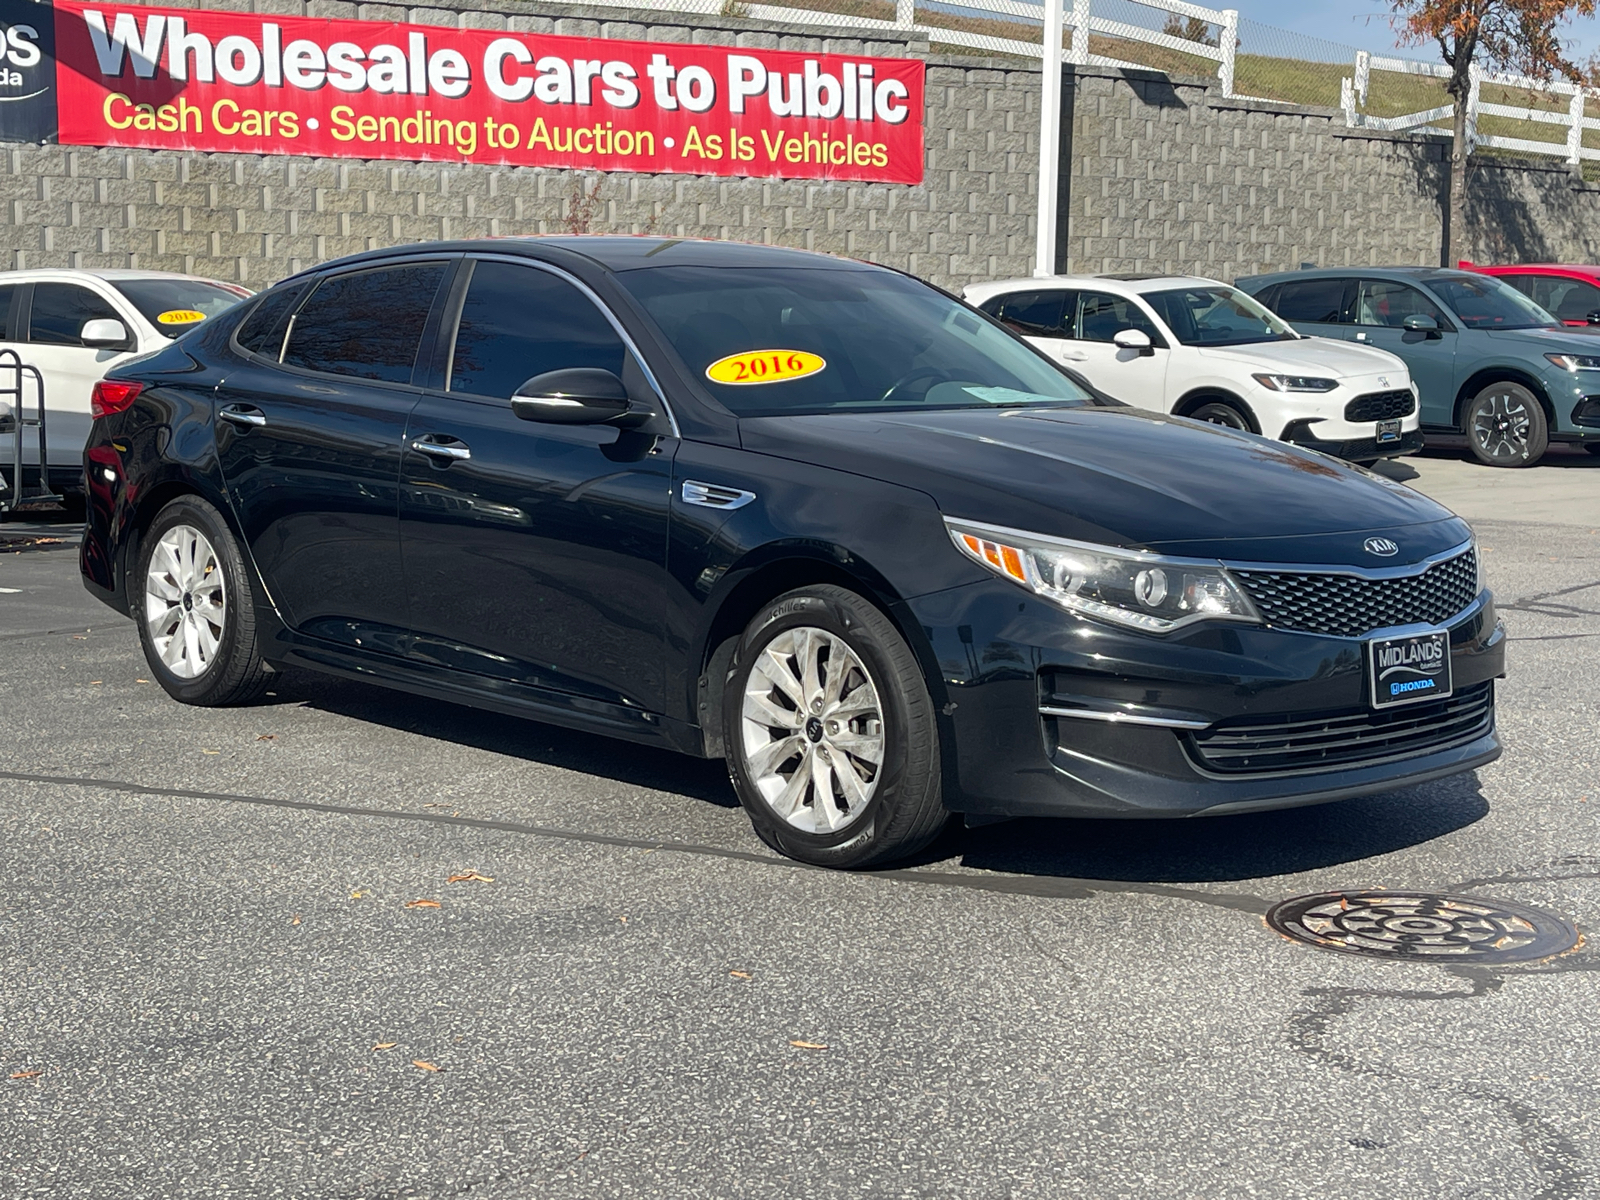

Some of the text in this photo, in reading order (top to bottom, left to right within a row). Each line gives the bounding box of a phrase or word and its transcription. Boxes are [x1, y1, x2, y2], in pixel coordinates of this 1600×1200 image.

[83, 9, 910, 123] Wholesale Cars to Public
[103, 93, 889, 168] Cash Cars Sending to Auction As Is Vehicles
[167, 312, 197, 323] 2015
[730, 353, 804, 381] 2016
[1368, 539, 1397, 552] KIA
[1379, 641, 1443, 668] MIDLANDS
[1400, 679, 1436, 692] HONDA
